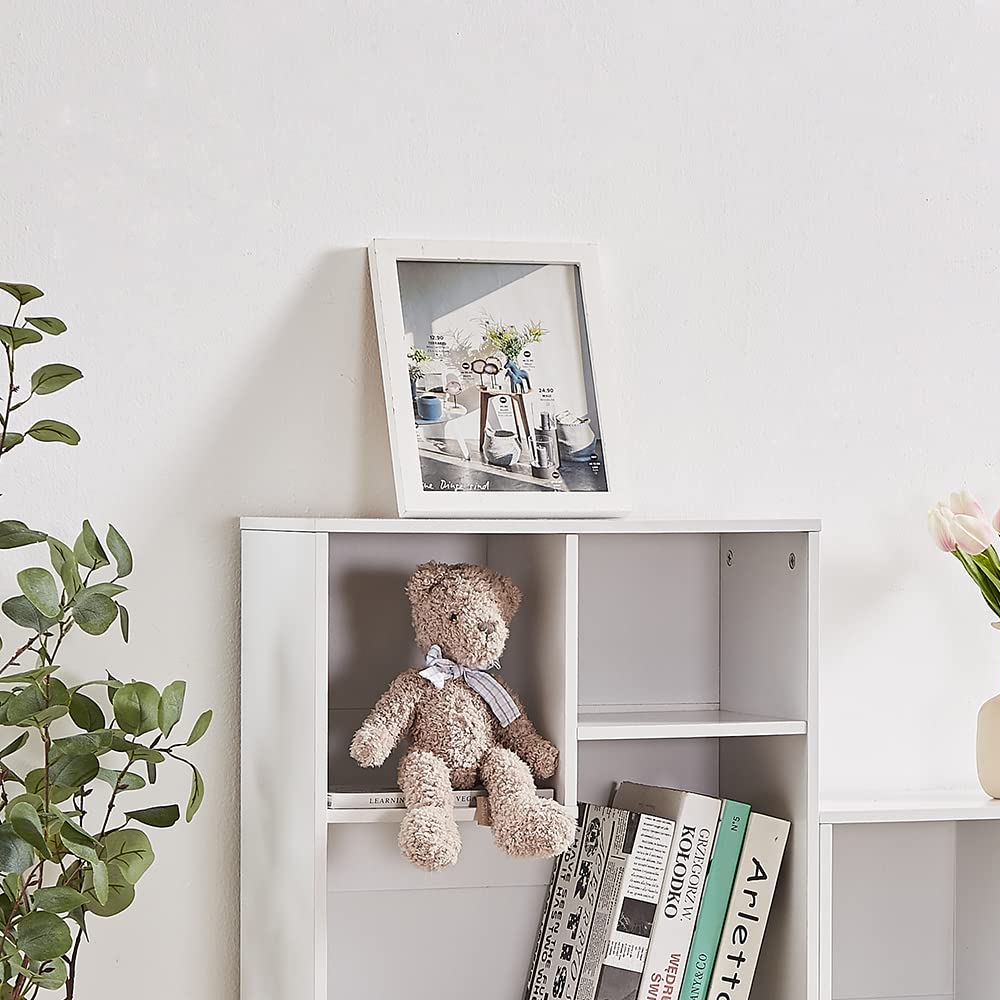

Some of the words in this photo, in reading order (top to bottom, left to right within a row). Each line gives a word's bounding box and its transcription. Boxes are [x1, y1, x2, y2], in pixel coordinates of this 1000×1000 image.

[663, 823, 697, 919] KOŁODKO
[684, 827, 711, 904] GRZEGORZ
[679, 906, 694, 921] W.
